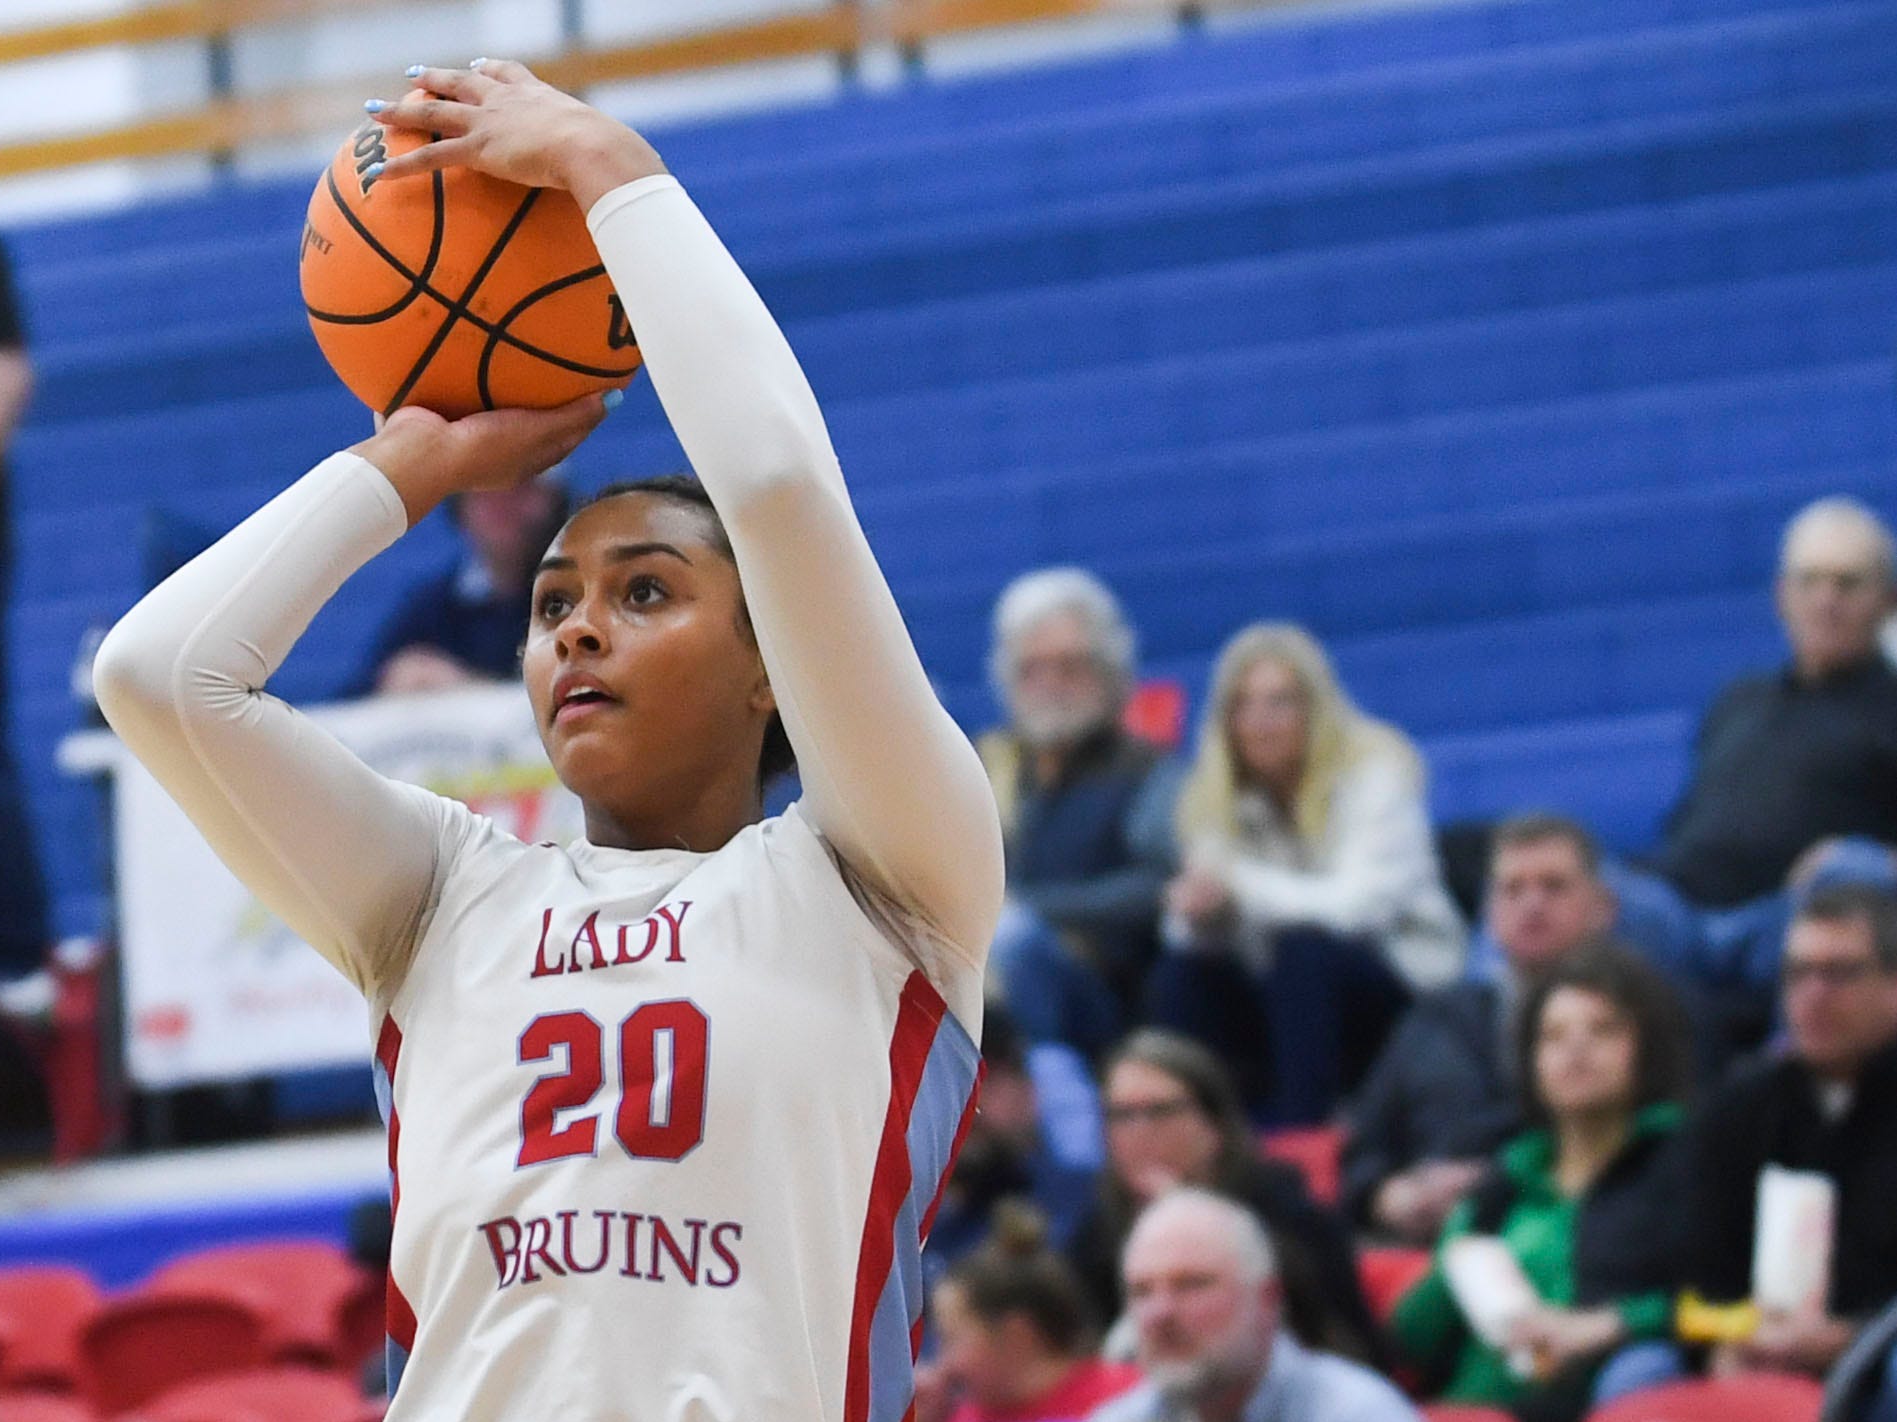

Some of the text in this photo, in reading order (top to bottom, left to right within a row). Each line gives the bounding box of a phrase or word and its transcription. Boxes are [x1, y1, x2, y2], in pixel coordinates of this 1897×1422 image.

[530, 901, 694, 979] LADY
[514, 997, 712, 1171] 20
[477, 1209, 743, 1291] BRUINS
